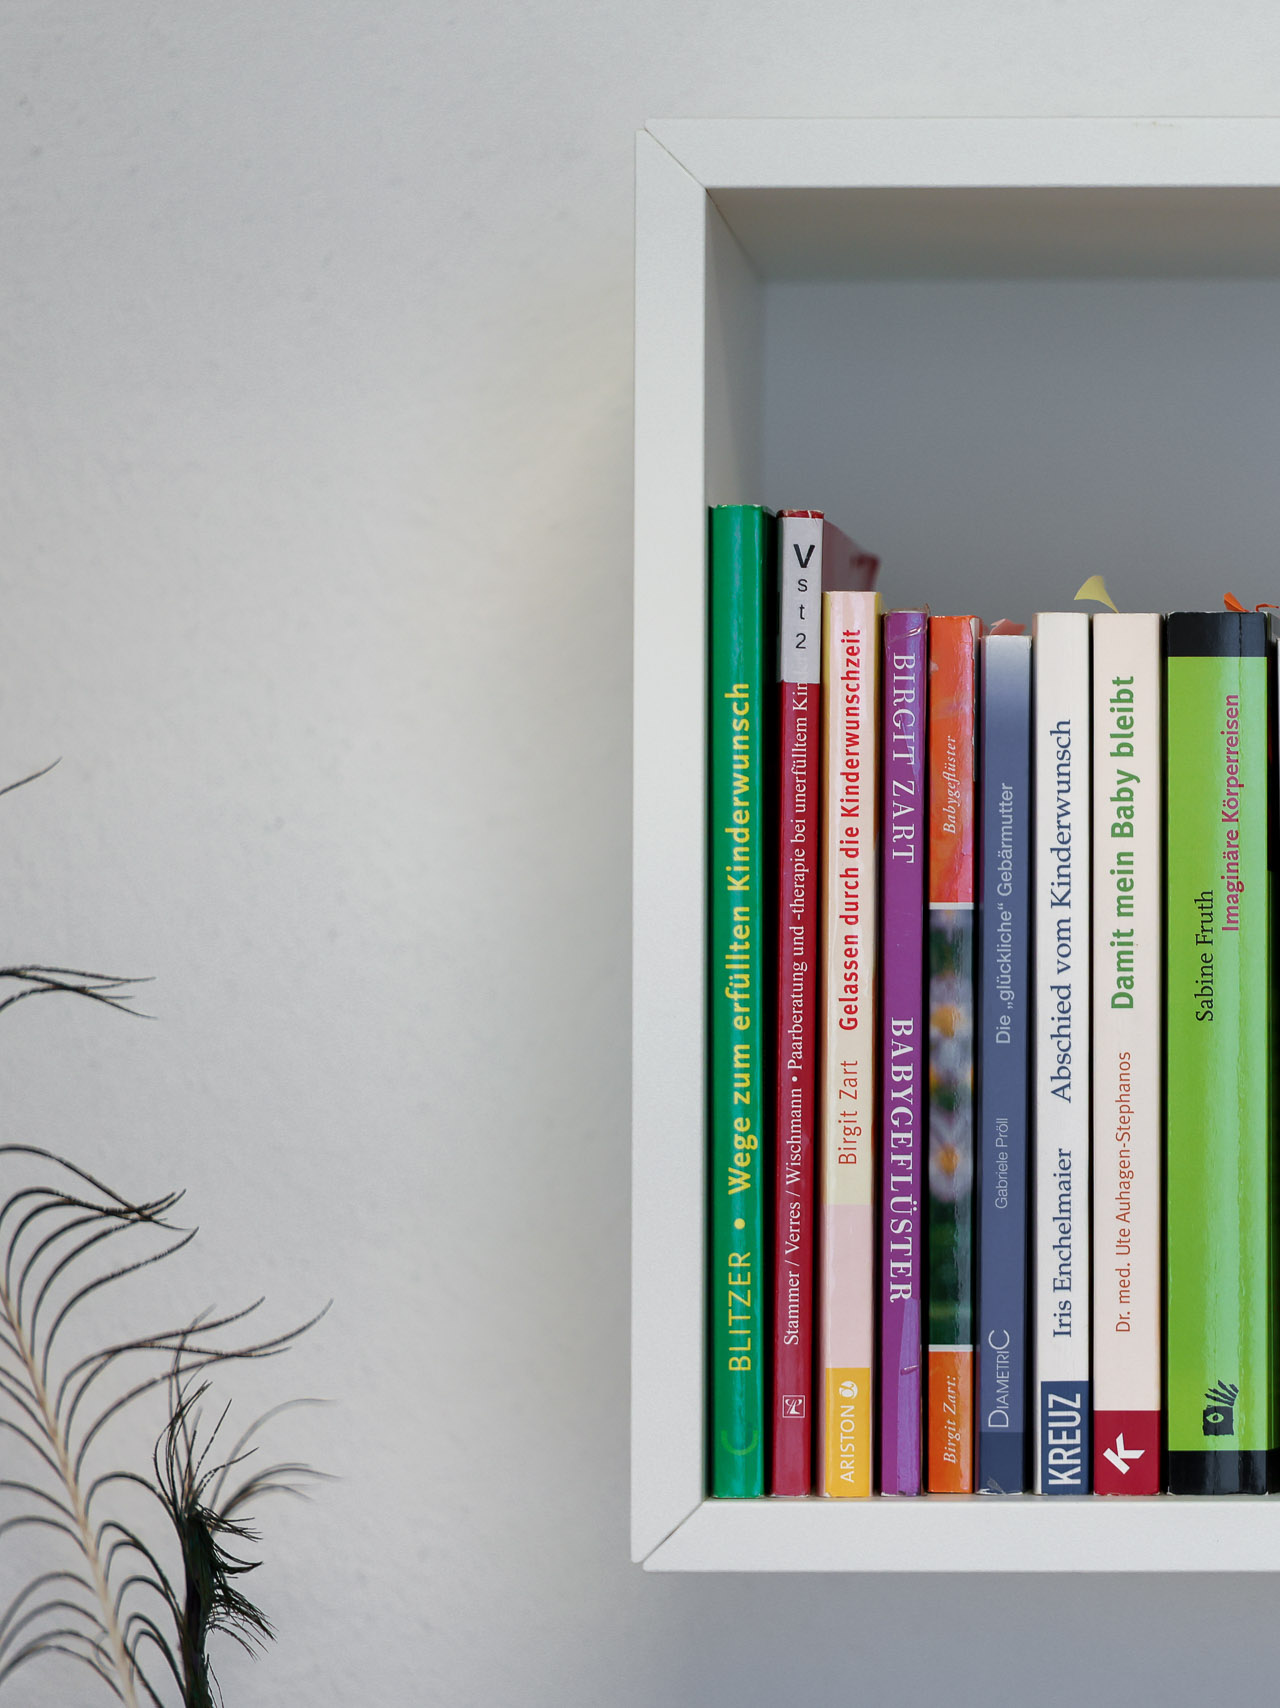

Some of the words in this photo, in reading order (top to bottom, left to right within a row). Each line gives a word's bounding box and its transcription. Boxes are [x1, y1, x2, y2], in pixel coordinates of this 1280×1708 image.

[840, 629, 861, 817] Kinderwunschzeit
[893, 653, 916, 765] BIRGIT
[1109, 675, 1135, 758] bleibt
[724, 683, 750, 891] Kinderwunsch
[790, 717, 808, 813] unerfülltem
[942, 735, 957, 835] Babygeflüster
[1220, 694, 1245, 823] Körperreisen
[790, 815, 806, 843] bei
[839, 827, 860, 851] die
[892, 780, 916, 863] ZART
[996, 782, 1014, 897] Gebärmutter
[1050, 719, 1072, 910] Kinderwunsch
[1109, 768, 1141, 838] Baby
[790, 848, 809, 921] -therapie
[839, 867, 859, 925] durch
[1109, 851, 1135, 918] mein
[1194, 889, 1214, 947] Fruth
[1220, 829, 1245, 932] Imaginäre
[725, 906, 751, 1030] erfüllten
[789, 925, 805, 957] und
[996, 902, 1015, 1010] „glückliche“
[1056, 916, 1072, 975] vom
[1109, 928, 1135, 1010] Damit
[787, 961, 808, 1070] Paarberatung
[838, 934, 859, 1031] Gelassen
[1194, 952, 1214, 1022] Sabine
[995, 1014, 1012, 1044] Die
[1050, 983, 1072, 1104] Abschied
[733, 1044, 751, 1104] zum
[839, 1060, 859, 1099] Zart
[728, 1117, 758, 1195] Wege
[786, 1087, 803, 1186] Wischmann
[838, 1110, 861, 1164] Birgit
[889, 1016, 918, 1303] BABYGEFLÜSTER
[994, 1117, 1009, 1148] Pröll
[1114, 1051, 1135, 1223] Auhagen-Stephanos
[994, 1151, 1010, 1209] Gabriele
[784, 1201, 800, 1255] Verres
[1052, 1147, 1072, 1293] Enchelmaier
[1115, 1227, 1131, 1256] Ute
[728, 1251, 751, 1371] BLITZER
[783, 1271, 800, 1345] Stammer
[1052, 1299, 1072, 1338] Iris
[1115, 1262, 1131, 1304] med.
[1115, 1310, 1131, 1333] Dr.
[942, 1375, 957, 1415] Zart:
[988, 1329, 1010, 1428] DIAMETRIC
[839, 1404, 855, 1483] ARISTON
[942, 1420, 961, 1464] Birgit
[1047, 1393, 1081, 1485] KREUZ
